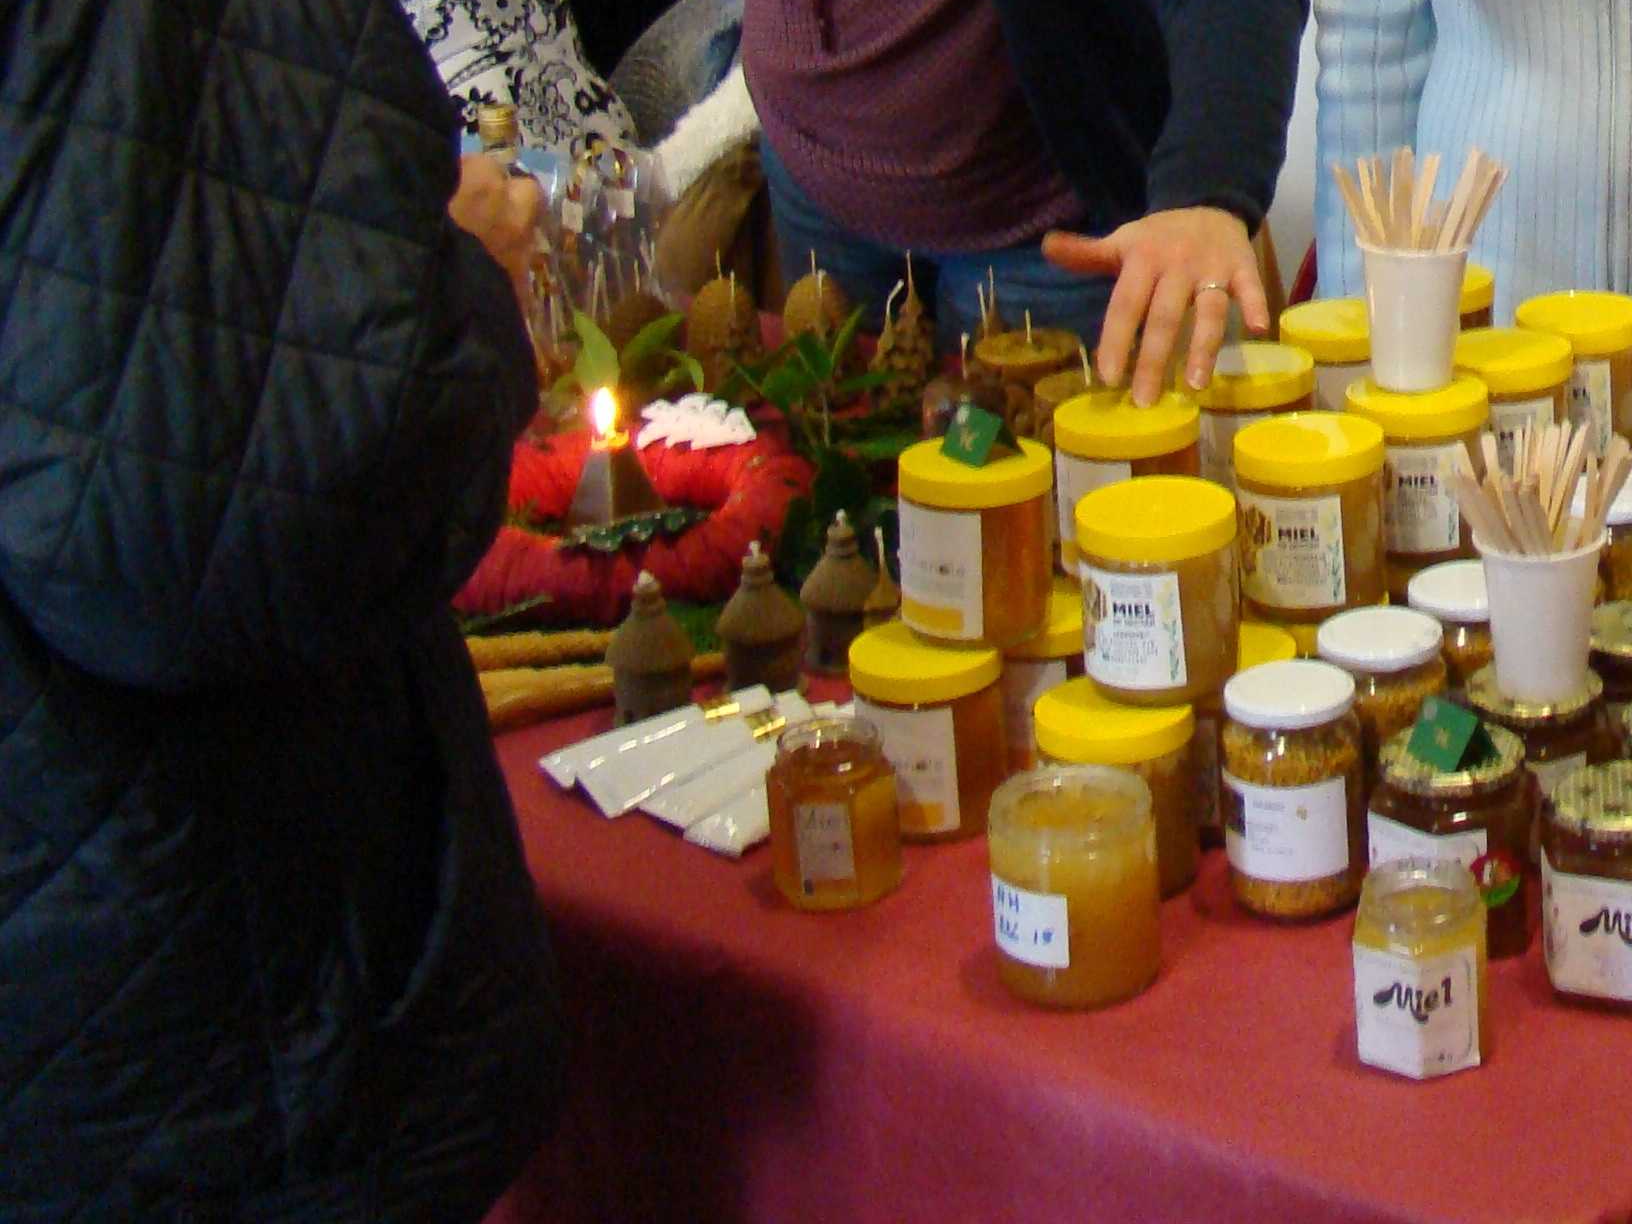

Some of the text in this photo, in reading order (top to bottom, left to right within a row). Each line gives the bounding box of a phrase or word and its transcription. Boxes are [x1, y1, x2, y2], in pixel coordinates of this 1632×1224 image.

[1278, 526, 1316, 540] MIEL
[1113, 602, 1152, 617] MIEL
[1373, 978, 1453, 1024] Miel
